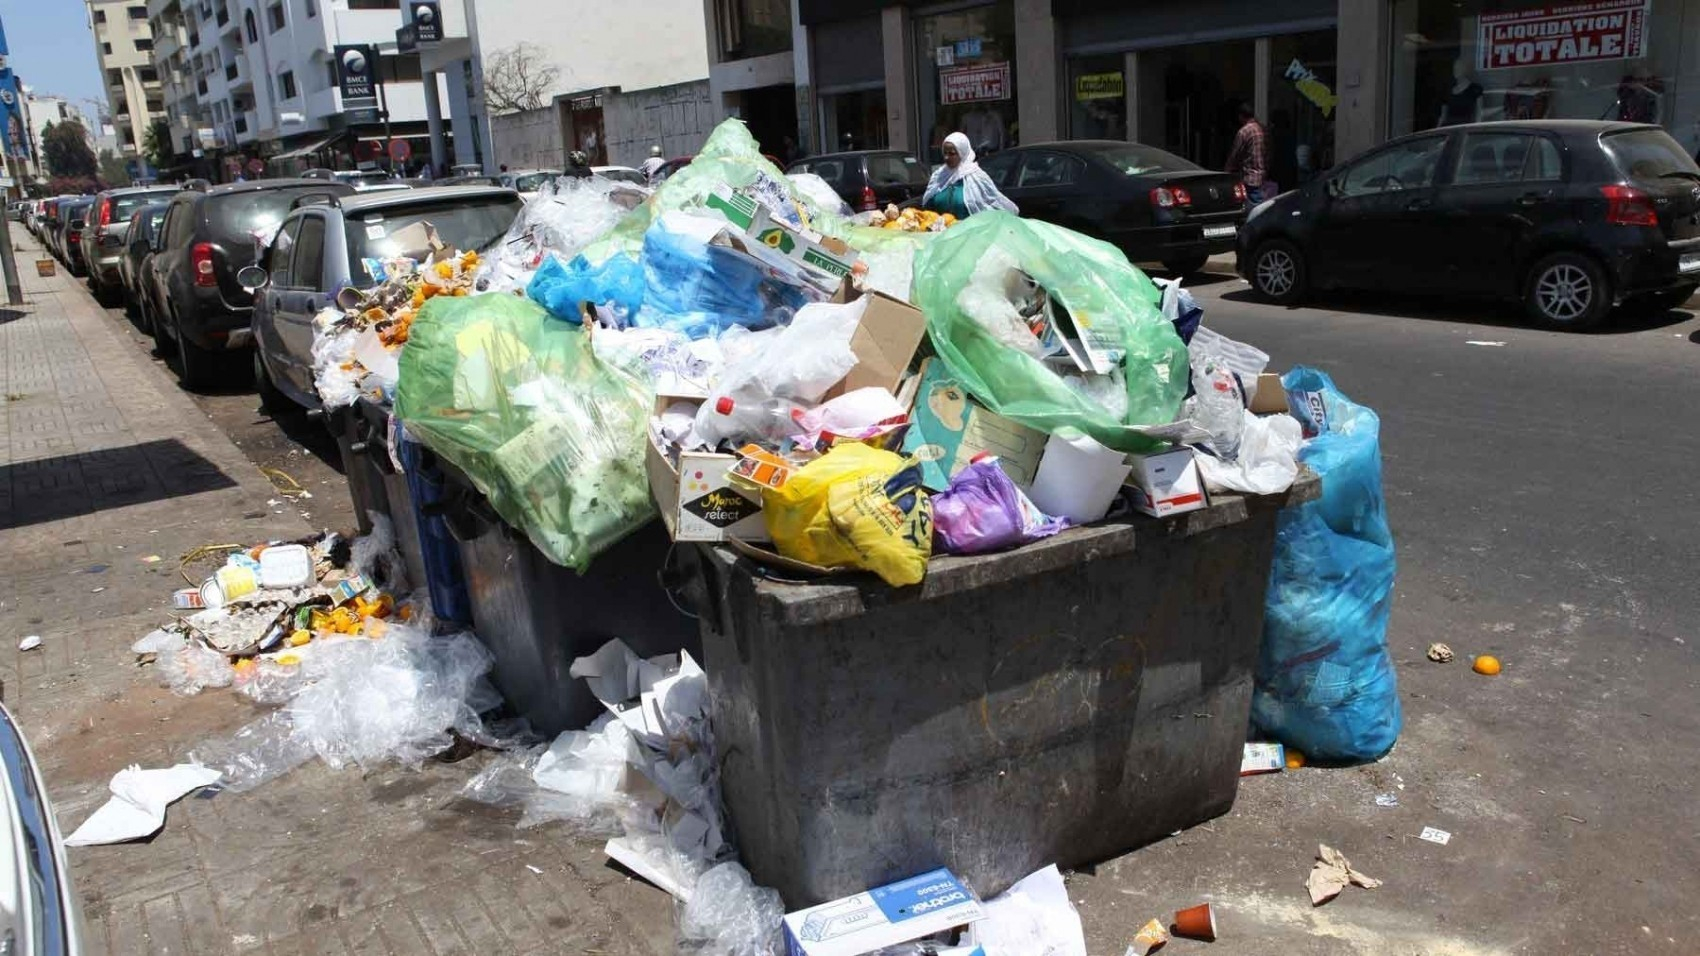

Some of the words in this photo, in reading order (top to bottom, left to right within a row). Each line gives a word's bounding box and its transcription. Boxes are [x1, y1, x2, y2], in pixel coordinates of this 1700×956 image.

[1495, 14, 1624, 40] LIQUIDATION
[1494, 34, 1622, 64] TOTALE
[348, 87, 369, 95] BANK
[948, 84, 1002, 100] TOTALE
[700, 493, 743, 509] Maroc
[704, 511, 740, 520] select
[912, 891, 965, 914] brother
